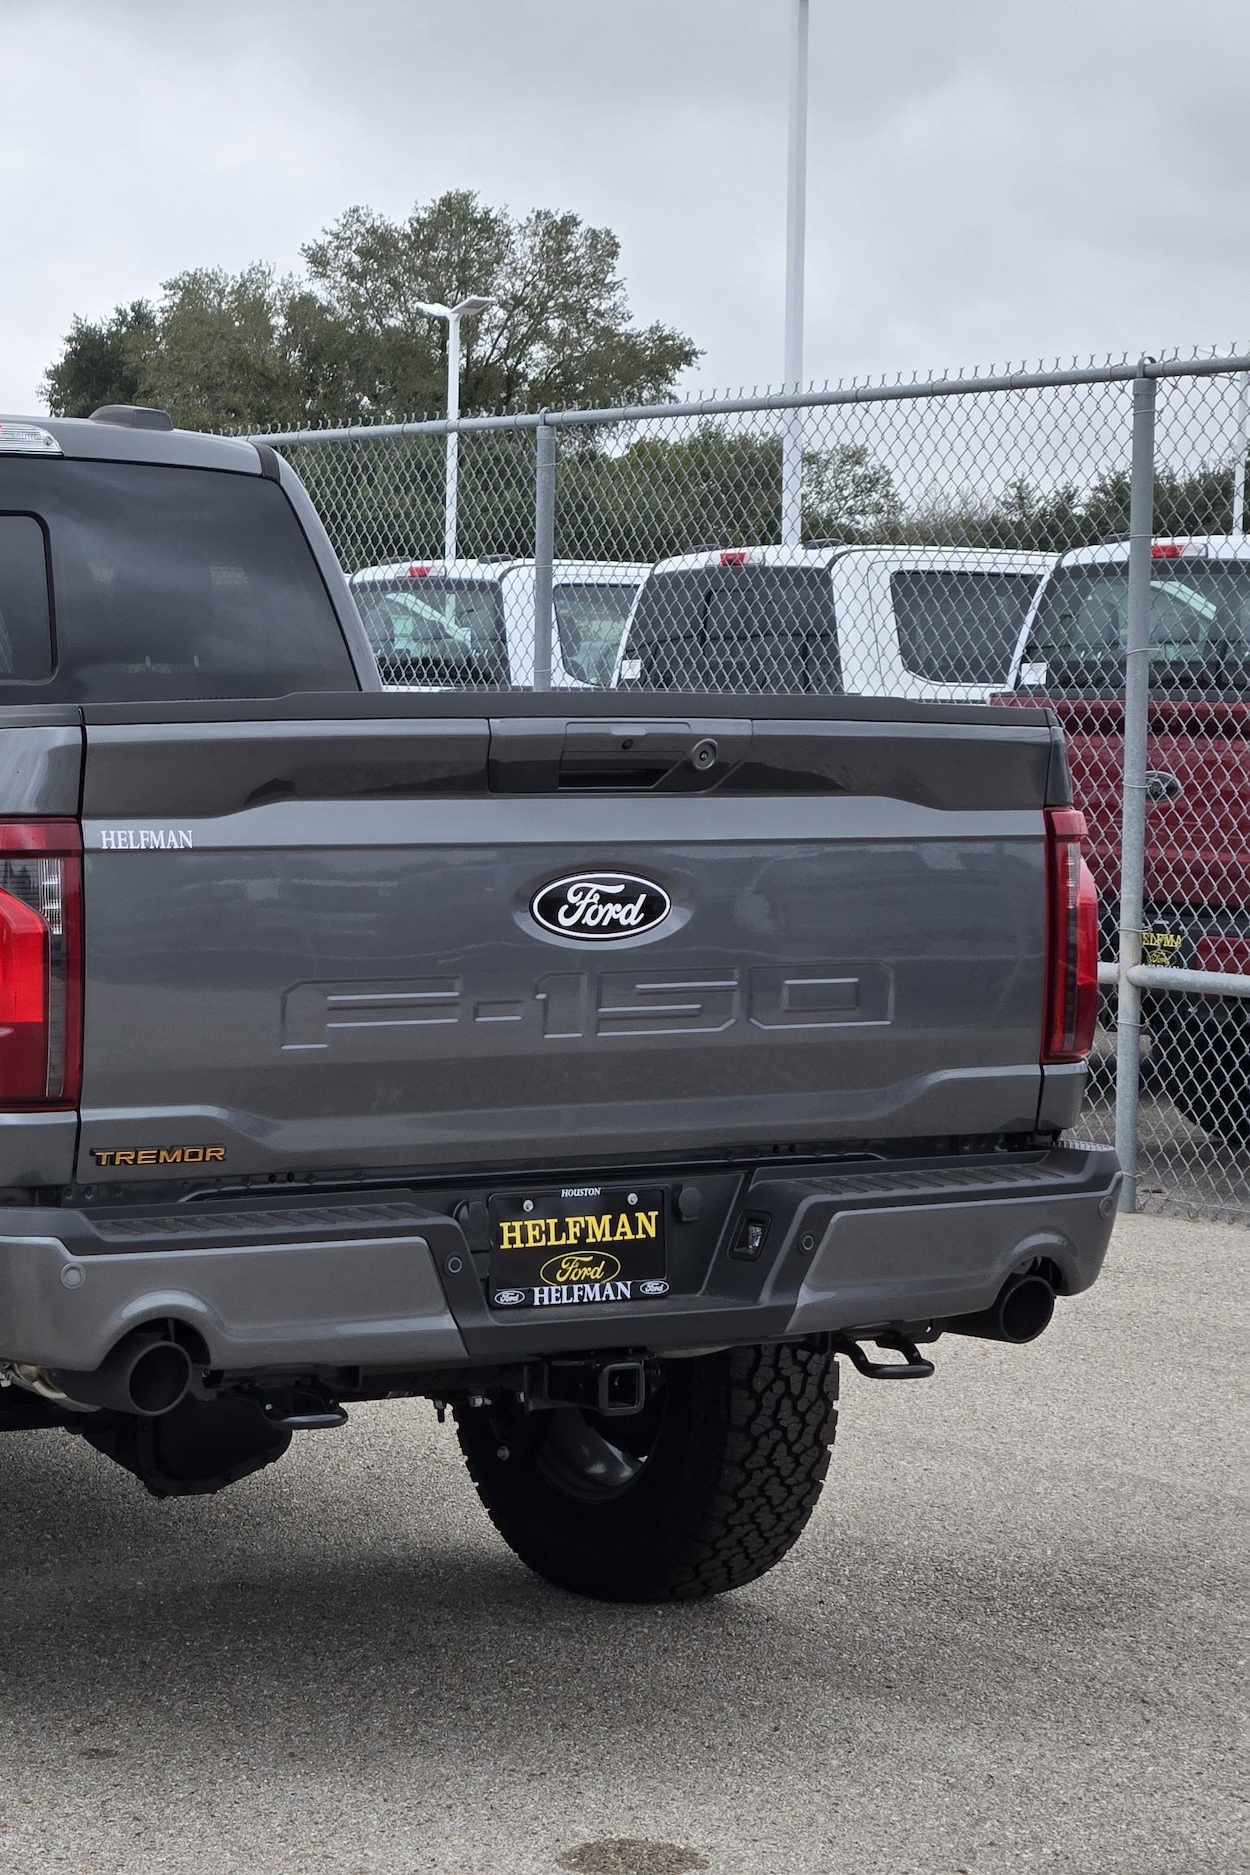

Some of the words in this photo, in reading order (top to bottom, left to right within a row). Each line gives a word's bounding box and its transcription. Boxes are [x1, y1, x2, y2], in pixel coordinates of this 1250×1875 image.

[100, 830, 193, 849] HELFMAN
[557, 882, 647, 927] Ford
[280, 962, 896, 1050] F-150
[94, 1146, 227, 1166] TREMOR
[561, 1187, 601, 1198] HOUSTON
[500, 1210, 659, 1249] HELFMAN
[555, 1255, 606, 1282] Ford
[533, 1280, 632, 1306] HELFMAN
